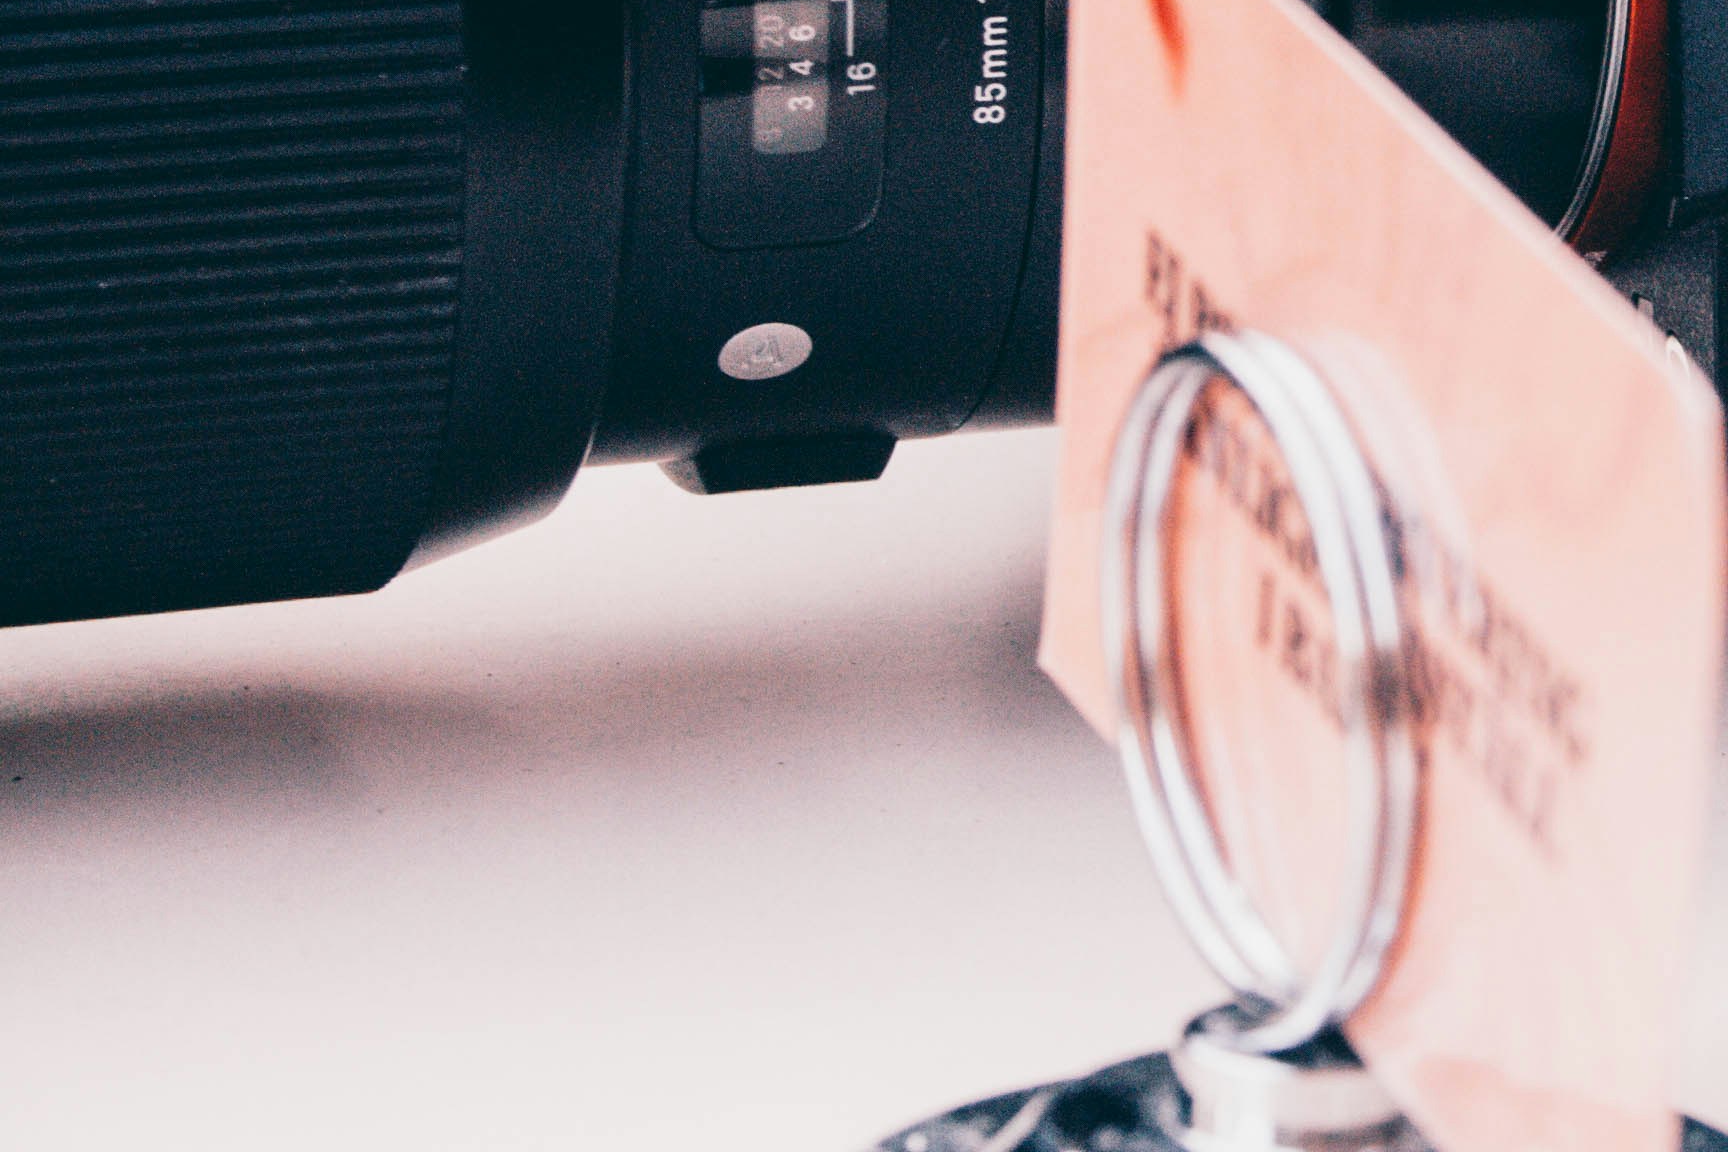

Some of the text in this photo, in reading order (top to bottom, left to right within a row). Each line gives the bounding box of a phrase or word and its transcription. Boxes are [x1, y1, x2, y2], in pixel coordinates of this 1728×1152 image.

[788, 24, 816, 112] 3 4 6
[846, 62, 876, 96] 16
[972, 15, 1007, 124] 85mm
